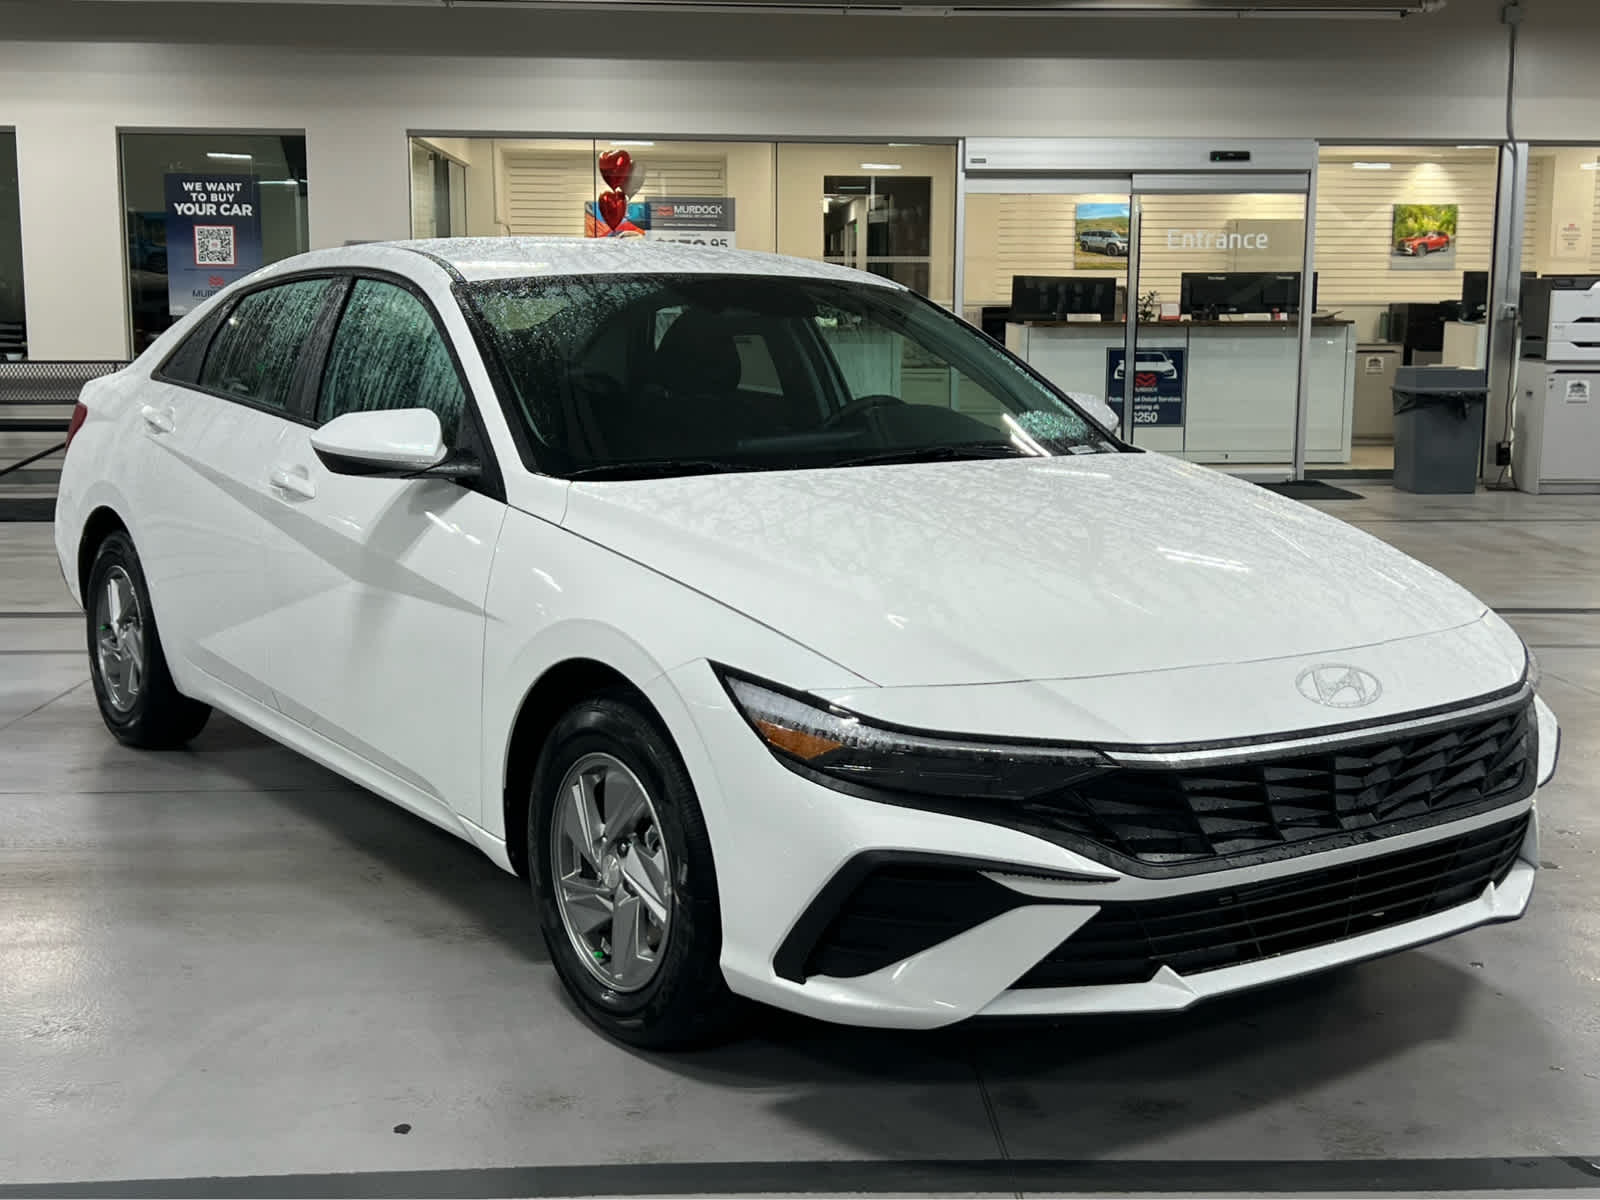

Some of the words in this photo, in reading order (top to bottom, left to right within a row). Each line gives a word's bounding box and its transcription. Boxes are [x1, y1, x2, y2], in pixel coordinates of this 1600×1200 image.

[182, 182, 202, 191] WE
[205, 182, 242, 192] WANT
[190, 193, 207, 202] TO
[210, 193, 235, 202] BUY
[174, 203, 216, 216] YOUR
[220, 203, 253, 216] CAR
[673, 205, 723, 214] MURDOCK
[1167, 230, 1269, 249] Entrance
